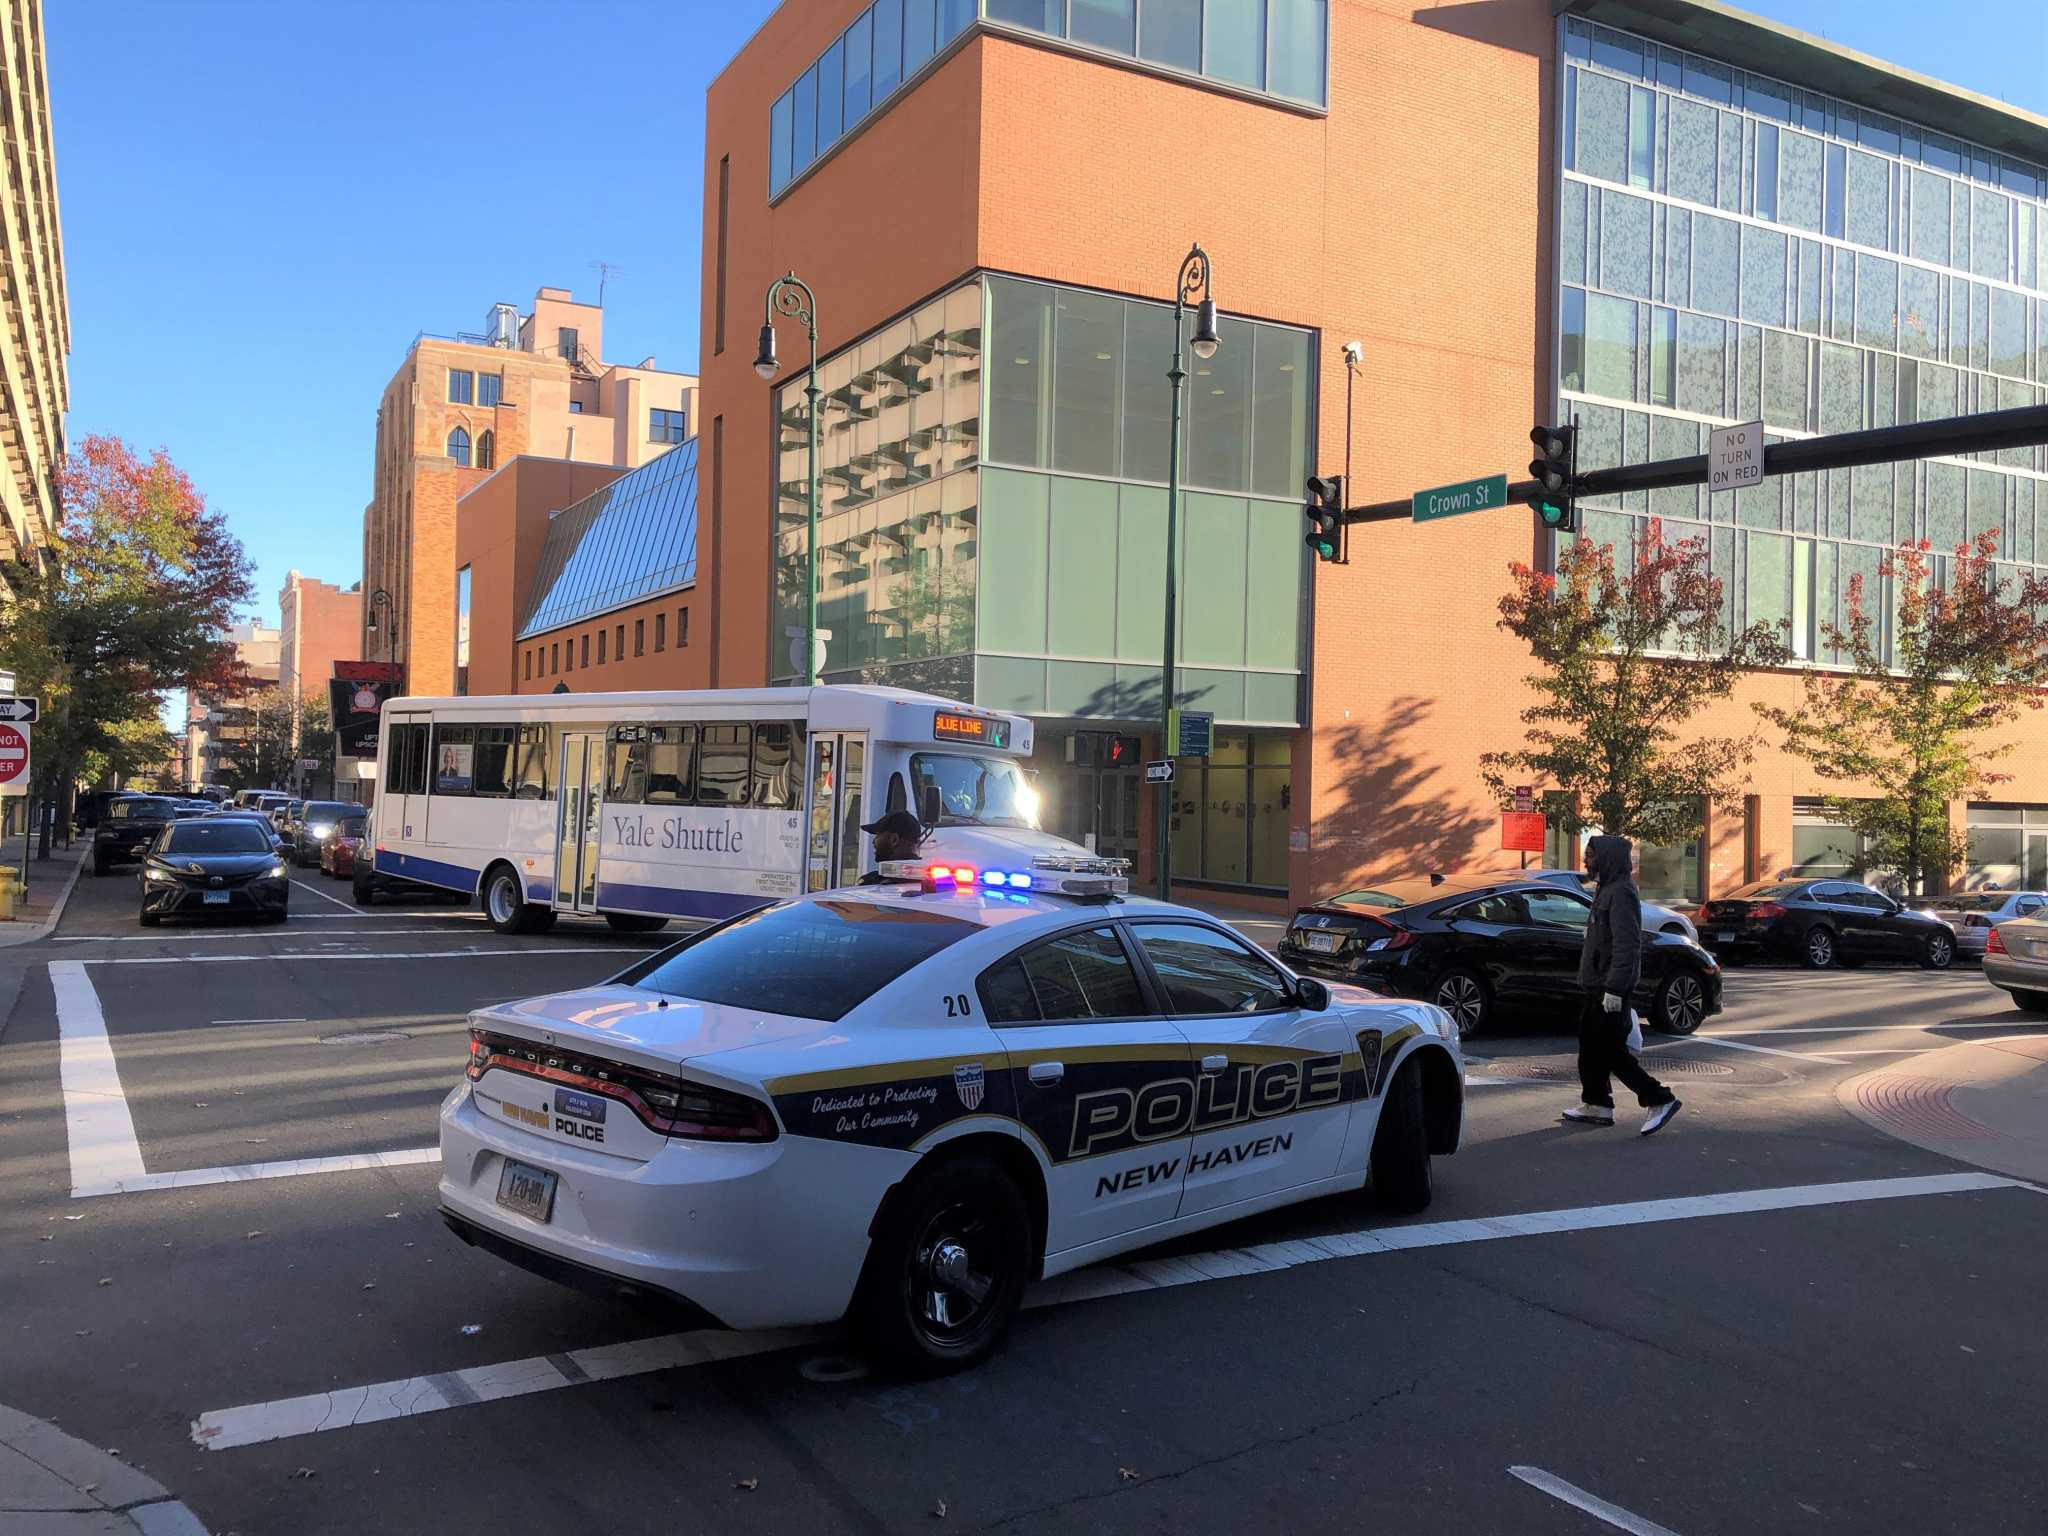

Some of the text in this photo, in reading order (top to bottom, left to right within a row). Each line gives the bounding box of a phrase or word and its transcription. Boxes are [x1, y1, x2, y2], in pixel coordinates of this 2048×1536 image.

[1726, 433, 1745, 447] NO
[1720, 448, 1752, 465] TURN
[1713, 465, 1758, 484] ON RED
[1429, 484, 1489, 514] Crown St
[936, 716, 982, 735] BLUE LINE
[1022, 739, 1030, 750] 45
[613, 815, 744, 854] Yale Shuttle
[787, 817, 798, 829] 45
[943, 993, 971, 1018] 20
[508, 1048, 608, 1080] DODGE
[812, 1086, 939, 1114] Dedicated to Protecting
[1067, 1051, 1343, 1158] POLICE
[554, 1117, 605, 1144] POLICE
[835, 1108, 920, 1133] Our Community
[1095, 1132, 1294, 1198] NEW HAVEN
